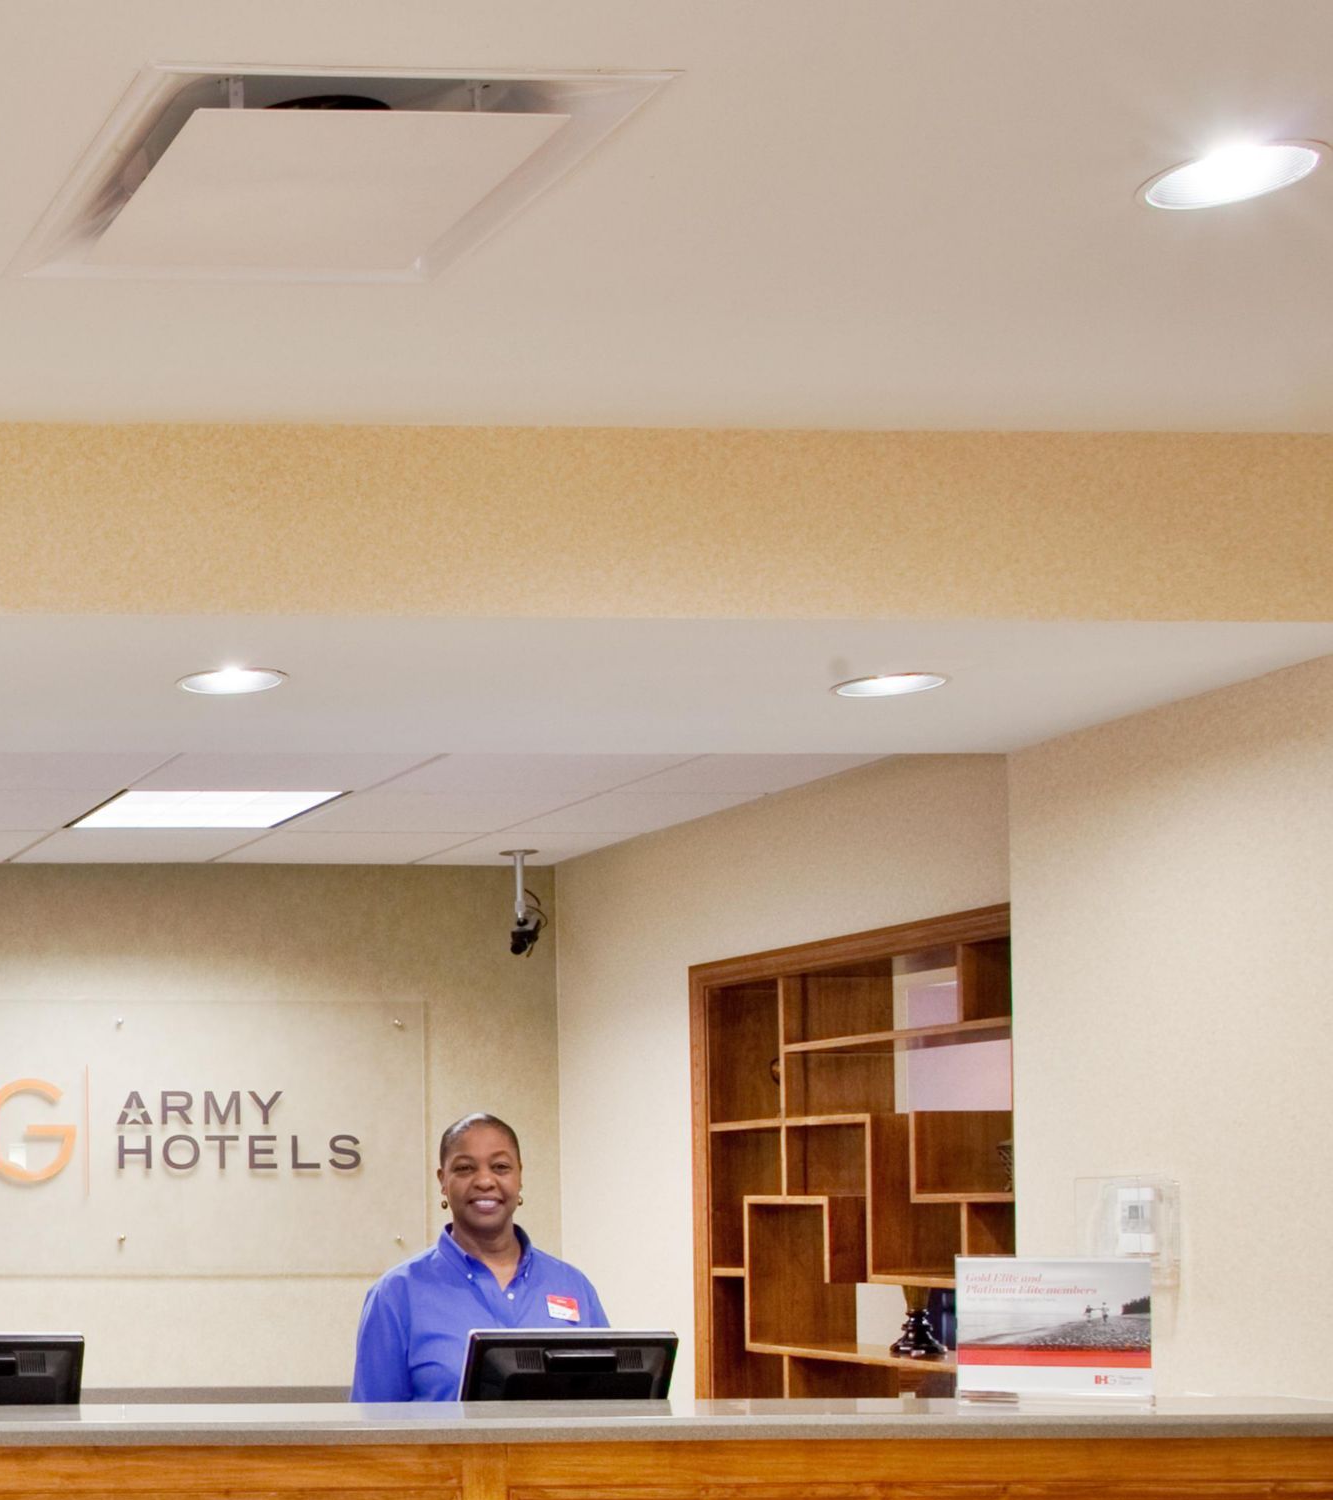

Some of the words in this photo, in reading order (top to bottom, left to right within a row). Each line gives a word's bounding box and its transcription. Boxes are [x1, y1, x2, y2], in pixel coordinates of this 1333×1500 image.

[116, 1090, 284, 1126] ARMY
[117, 1134, 363, 1171] HOTELS
[965, 1273, 991, 1283] Gold
[993, 1273, 1019, 1283] Elite
[1020, 1273, 1042, 1283] and
[965, 1285, 1016, 1295] Platinum
[1018, 1285, 1044, 1295] Elite
[1045, 1285, 1098, 1295] members
